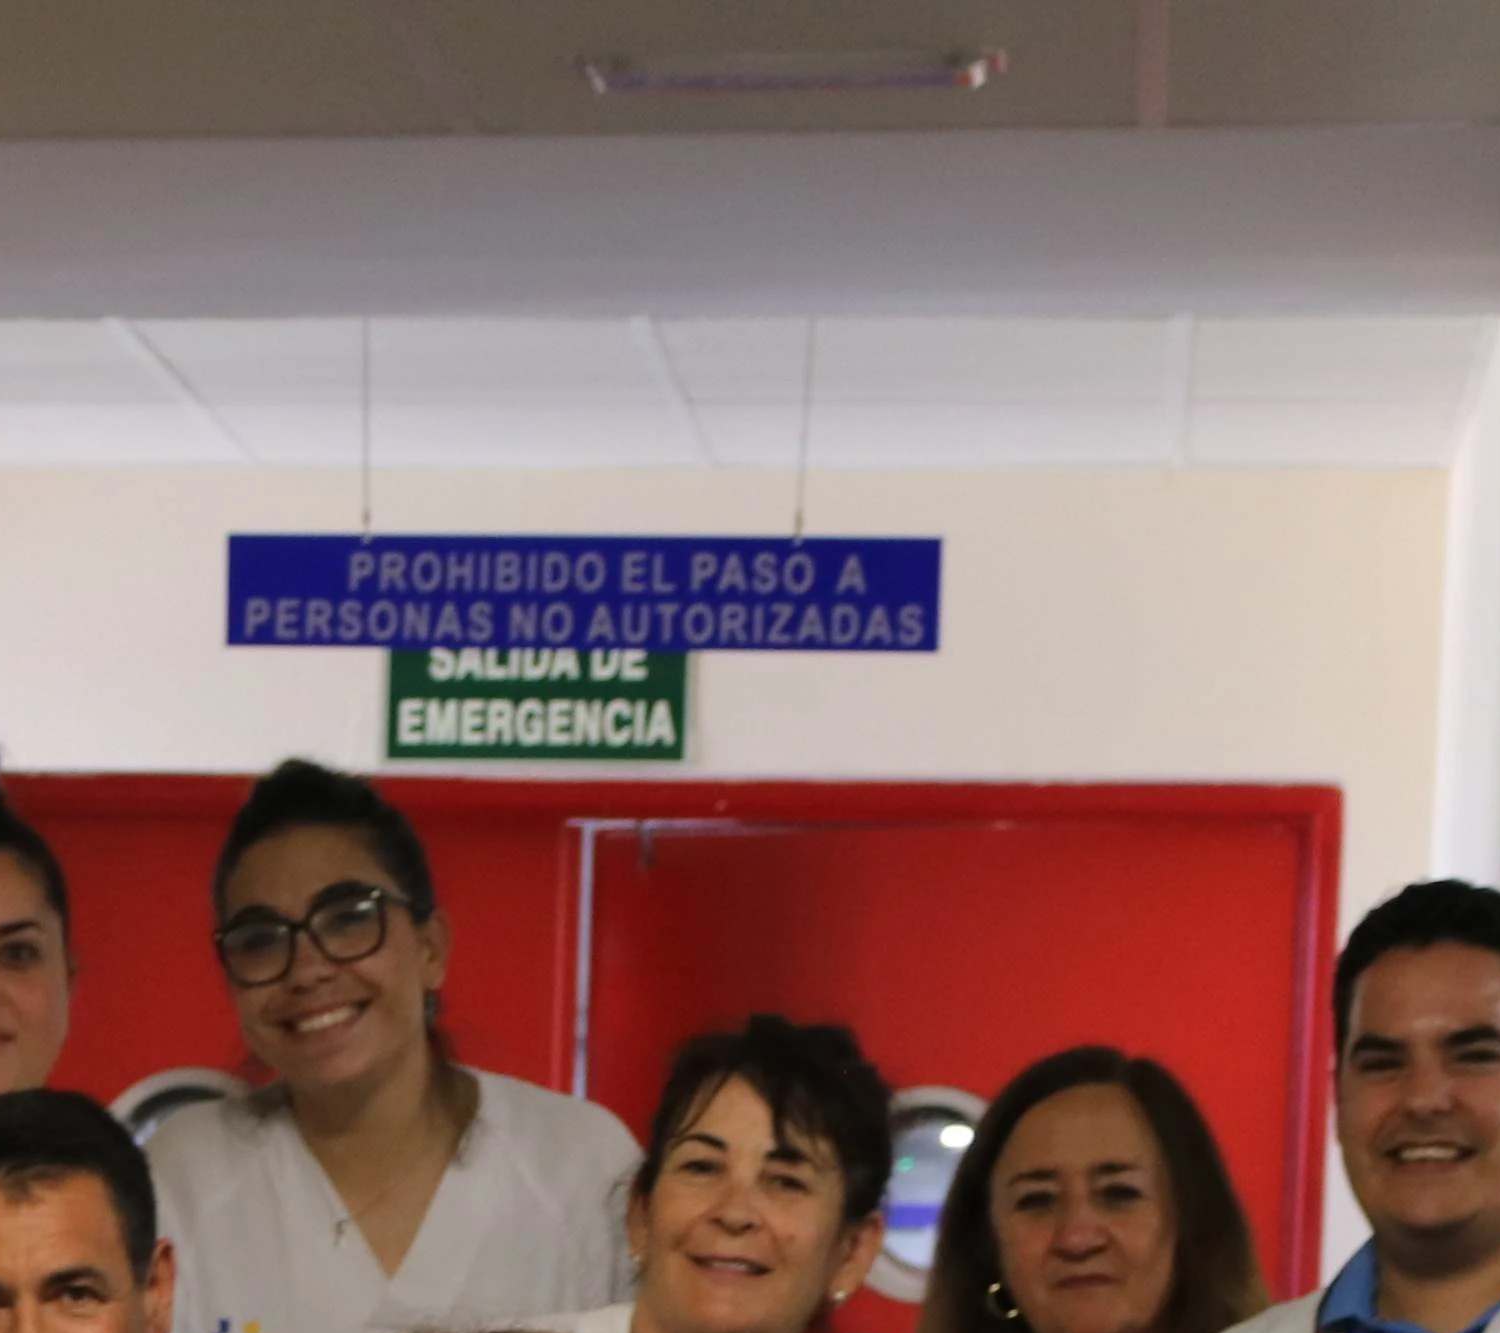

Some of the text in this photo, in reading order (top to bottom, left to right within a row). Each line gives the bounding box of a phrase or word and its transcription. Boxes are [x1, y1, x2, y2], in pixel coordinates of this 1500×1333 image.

[349, 551, 868, 595] PROHIBIDO EL PASO A
[243, 598, 924, 646] PERSONAS NO AUTORIZADAS
[427, 647, 649, 682] SALIDA DE
[396, 698, 677, 746] EMERGENCIA
